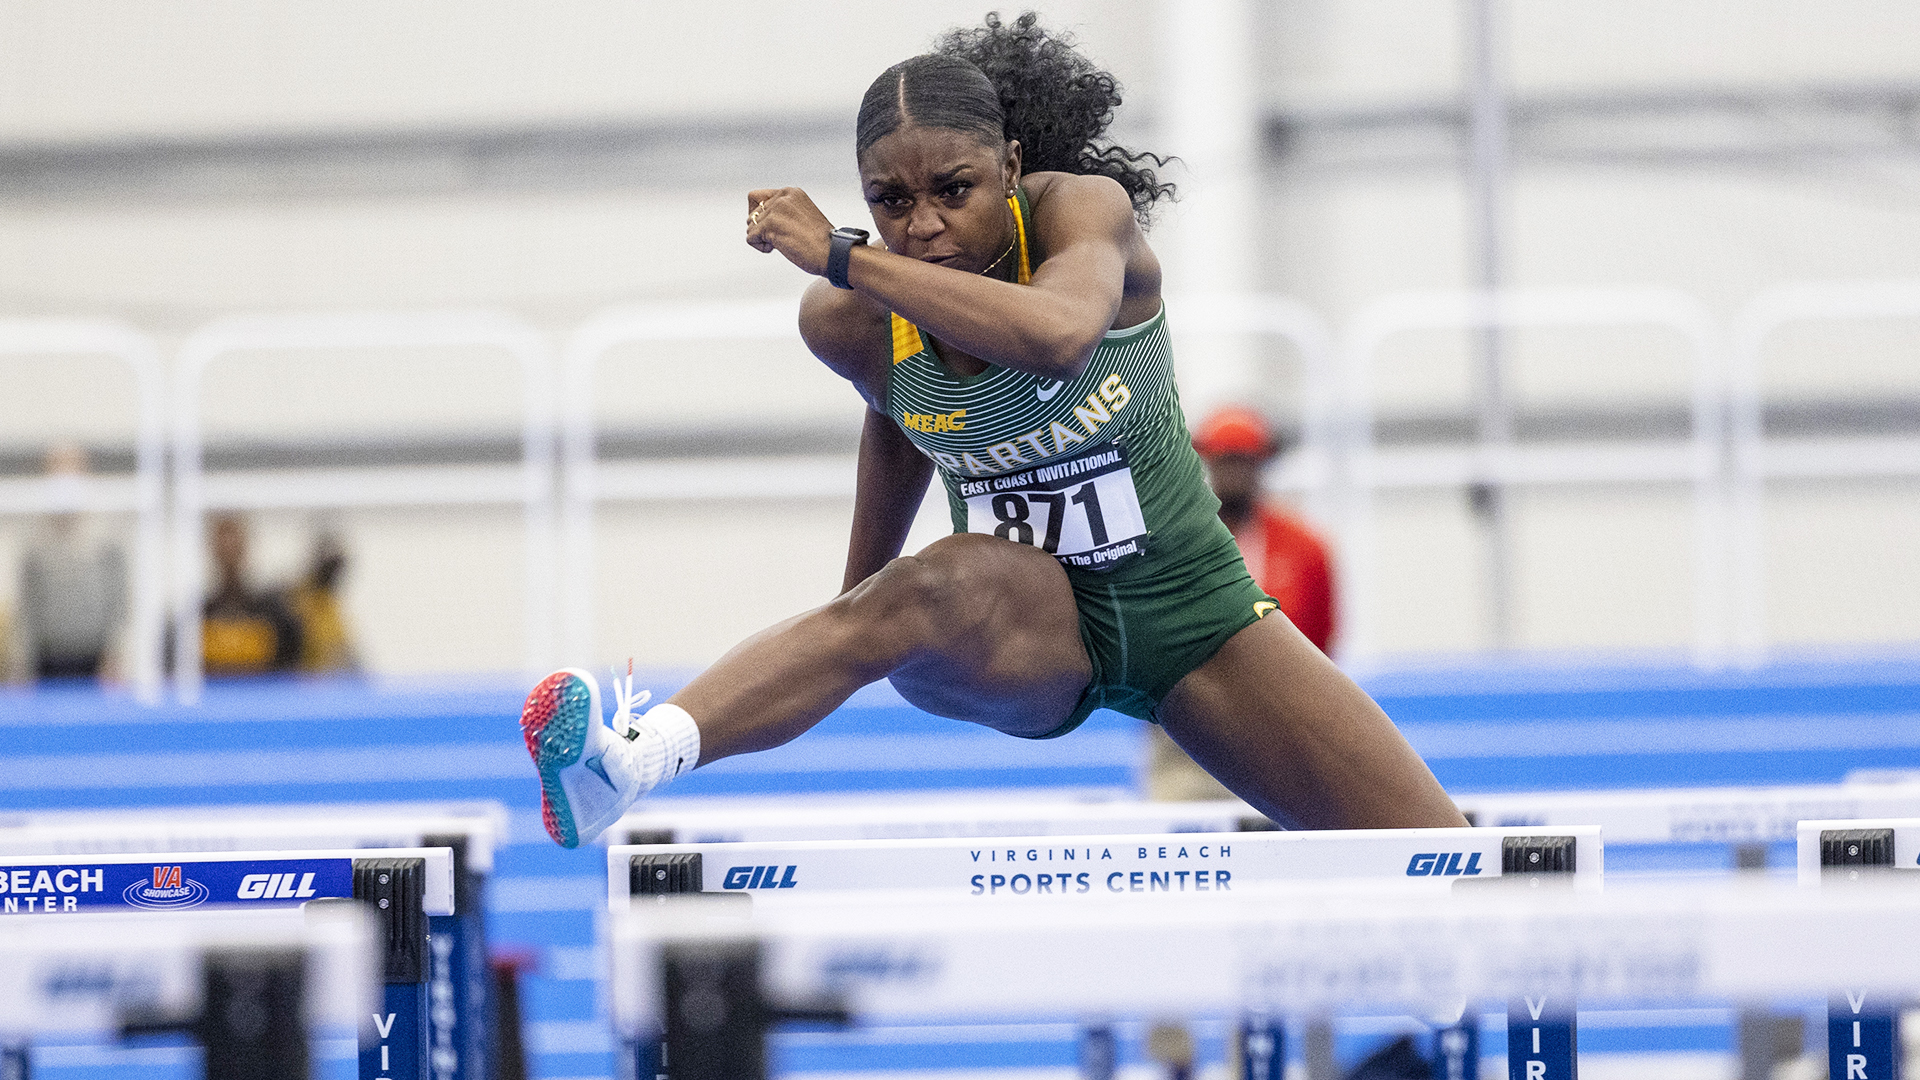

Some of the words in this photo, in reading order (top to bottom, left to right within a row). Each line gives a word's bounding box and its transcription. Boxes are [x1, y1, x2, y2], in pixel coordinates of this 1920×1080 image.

[904, 409, 967, 432] MEAC
[914, 373, 1132, 476] PARTANS
[960, 479, 992, 497] EAST
[994, 472, 1034, 491] COAST
[1037, 450, 1123, 483] INVITATIONAL
[991, 481, 1110, 553] 871
[1069, 556, 1092, 566] The
[1093, 540, 1138, 564] Original
[970, 848, 1112, 862] VIRGINIA
[1138, 846, 1231, 859] BEACH
[1406, 852, 1483, 877] GILL
[153, 866, 183, 888] VA
[237, 872, 316, 899] GILL
[722, 865, 798, 890] GILL
[970, 872, 1091, 896] SPORTS
[1106, 870, 1232, 893] CENTER
[143, 886, 191, 899] SHOWCASE
